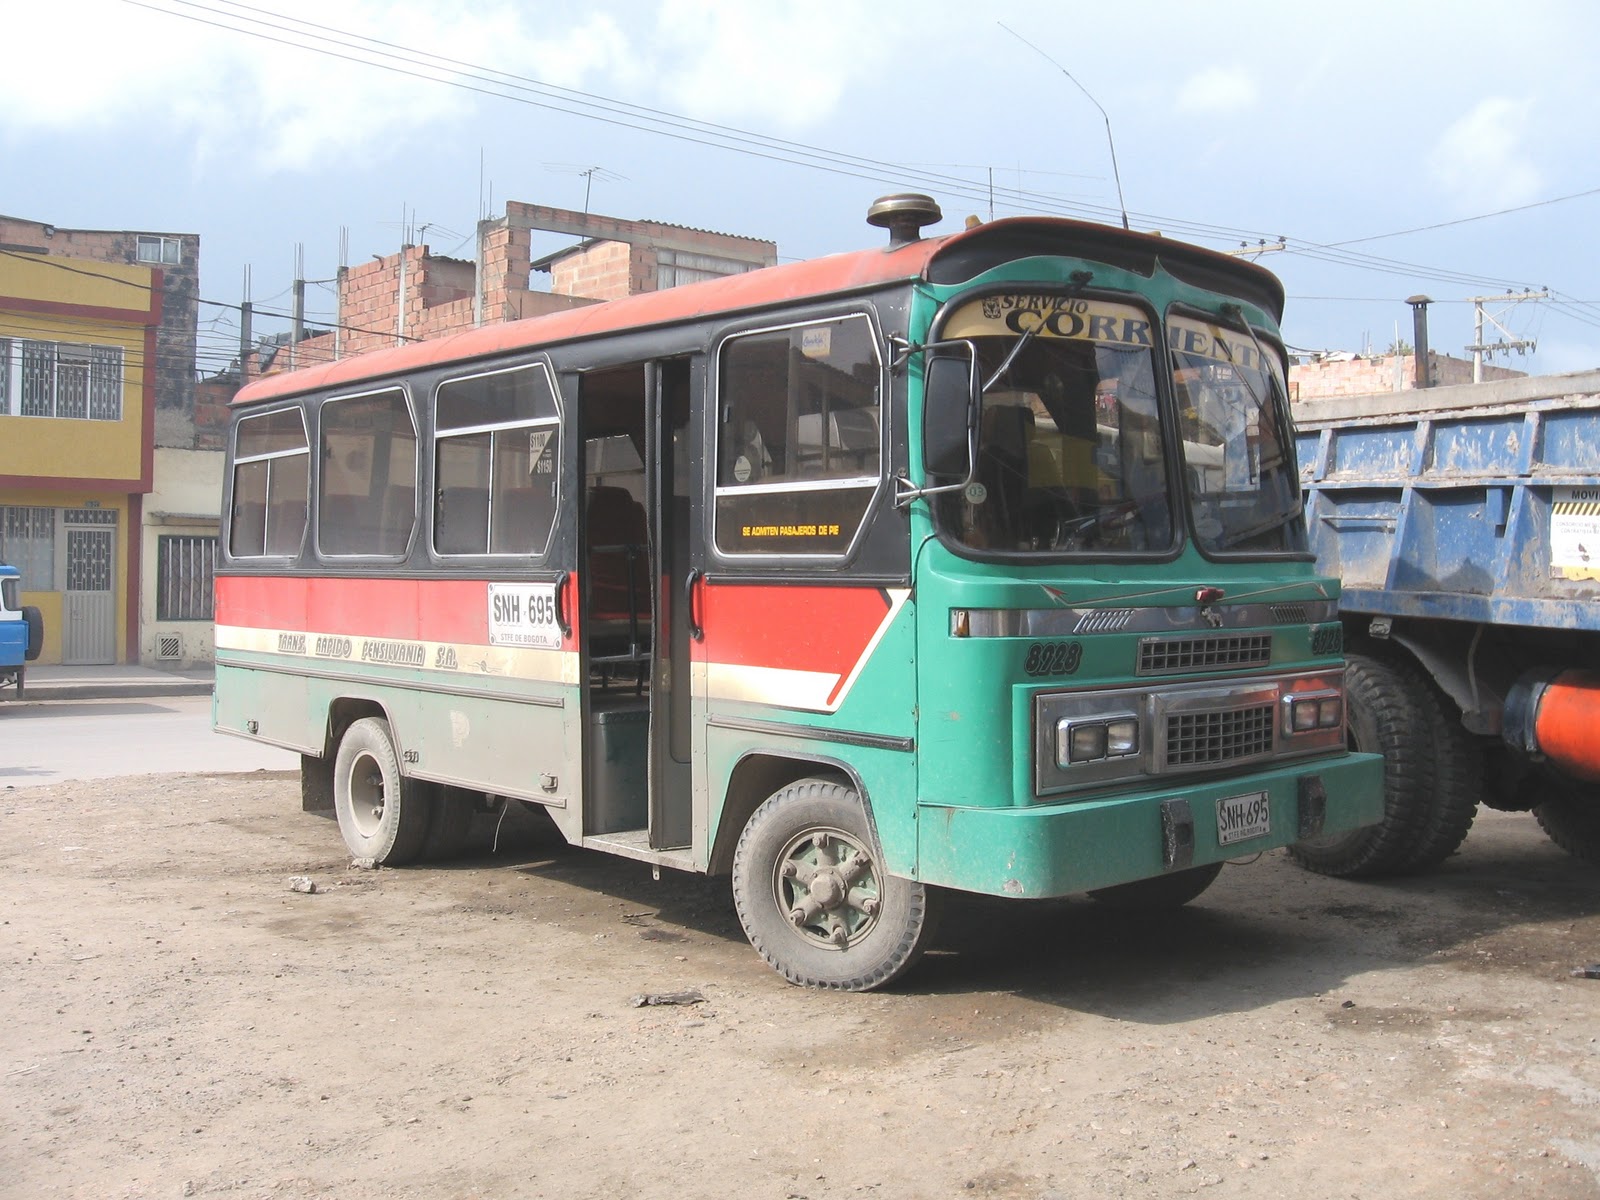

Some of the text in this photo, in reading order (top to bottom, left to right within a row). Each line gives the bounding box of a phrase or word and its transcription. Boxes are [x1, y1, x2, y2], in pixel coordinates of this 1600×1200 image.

[1001, 295, 1088, 314] SERVICIO
[1571, 490, 1600, 500] MOVI
[742, 525, 839, 536] SE ADMITEN PASAJEROS DE PIE
[493, 594, 554, 625] SNH 695
[524, 634, 548, 644] BOGOTA
[315, 636, 352, 659] RAPIDO
[361, 640, 426, 667] PENSILVANIA
[1220, 799, 1268, 831] SNH 695
